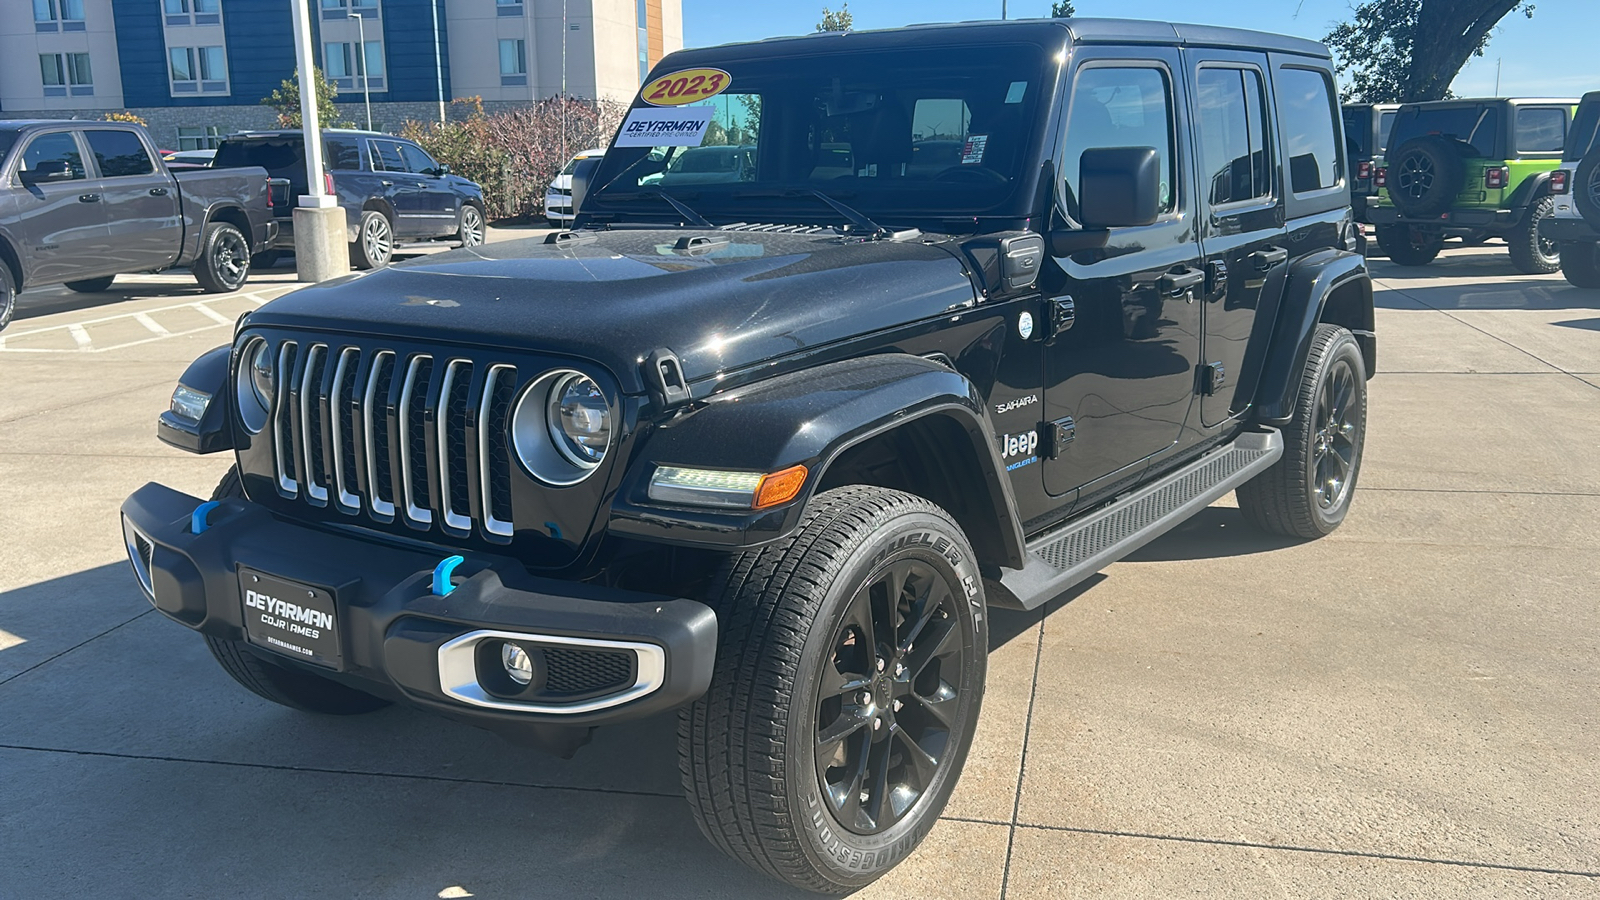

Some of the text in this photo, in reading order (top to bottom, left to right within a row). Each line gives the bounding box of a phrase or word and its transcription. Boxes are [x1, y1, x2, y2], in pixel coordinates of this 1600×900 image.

[648, 73, 724, 100] 2023
[626, 121, 705, 132] DEYARMAN
[996, 394, 1038, 414] SAHARA
[1001, 430, 1038, 459] Jeep
[246, 589, 333, 631] DEYARMAN
[261, 613, 320, 639] CDJR AMES
